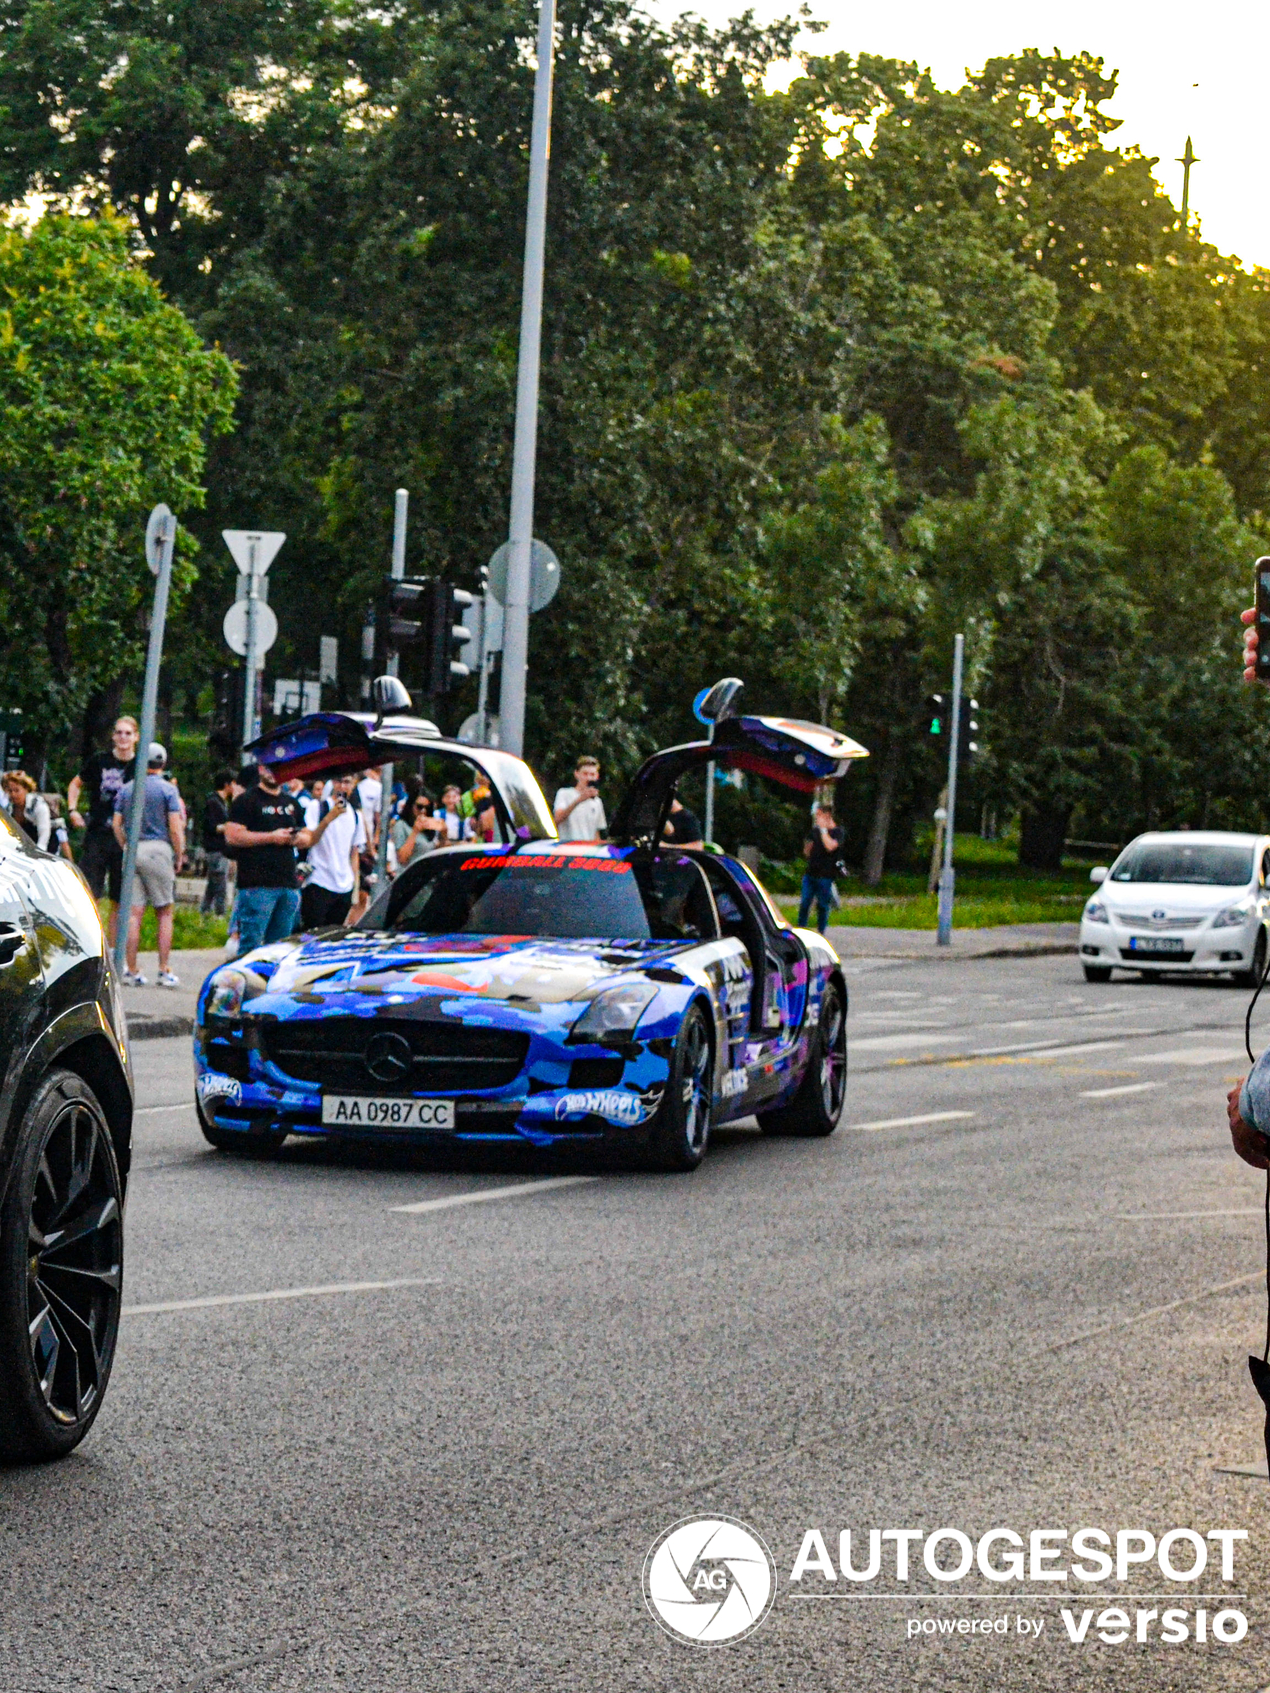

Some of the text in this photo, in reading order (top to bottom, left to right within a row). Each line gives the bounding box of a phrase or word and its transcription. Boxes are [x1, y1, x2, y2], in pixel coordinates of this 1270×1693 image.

[460, 855, 566, 870] GUMBALL
[335, 1101, 448, 1124] AA 0987 CC
